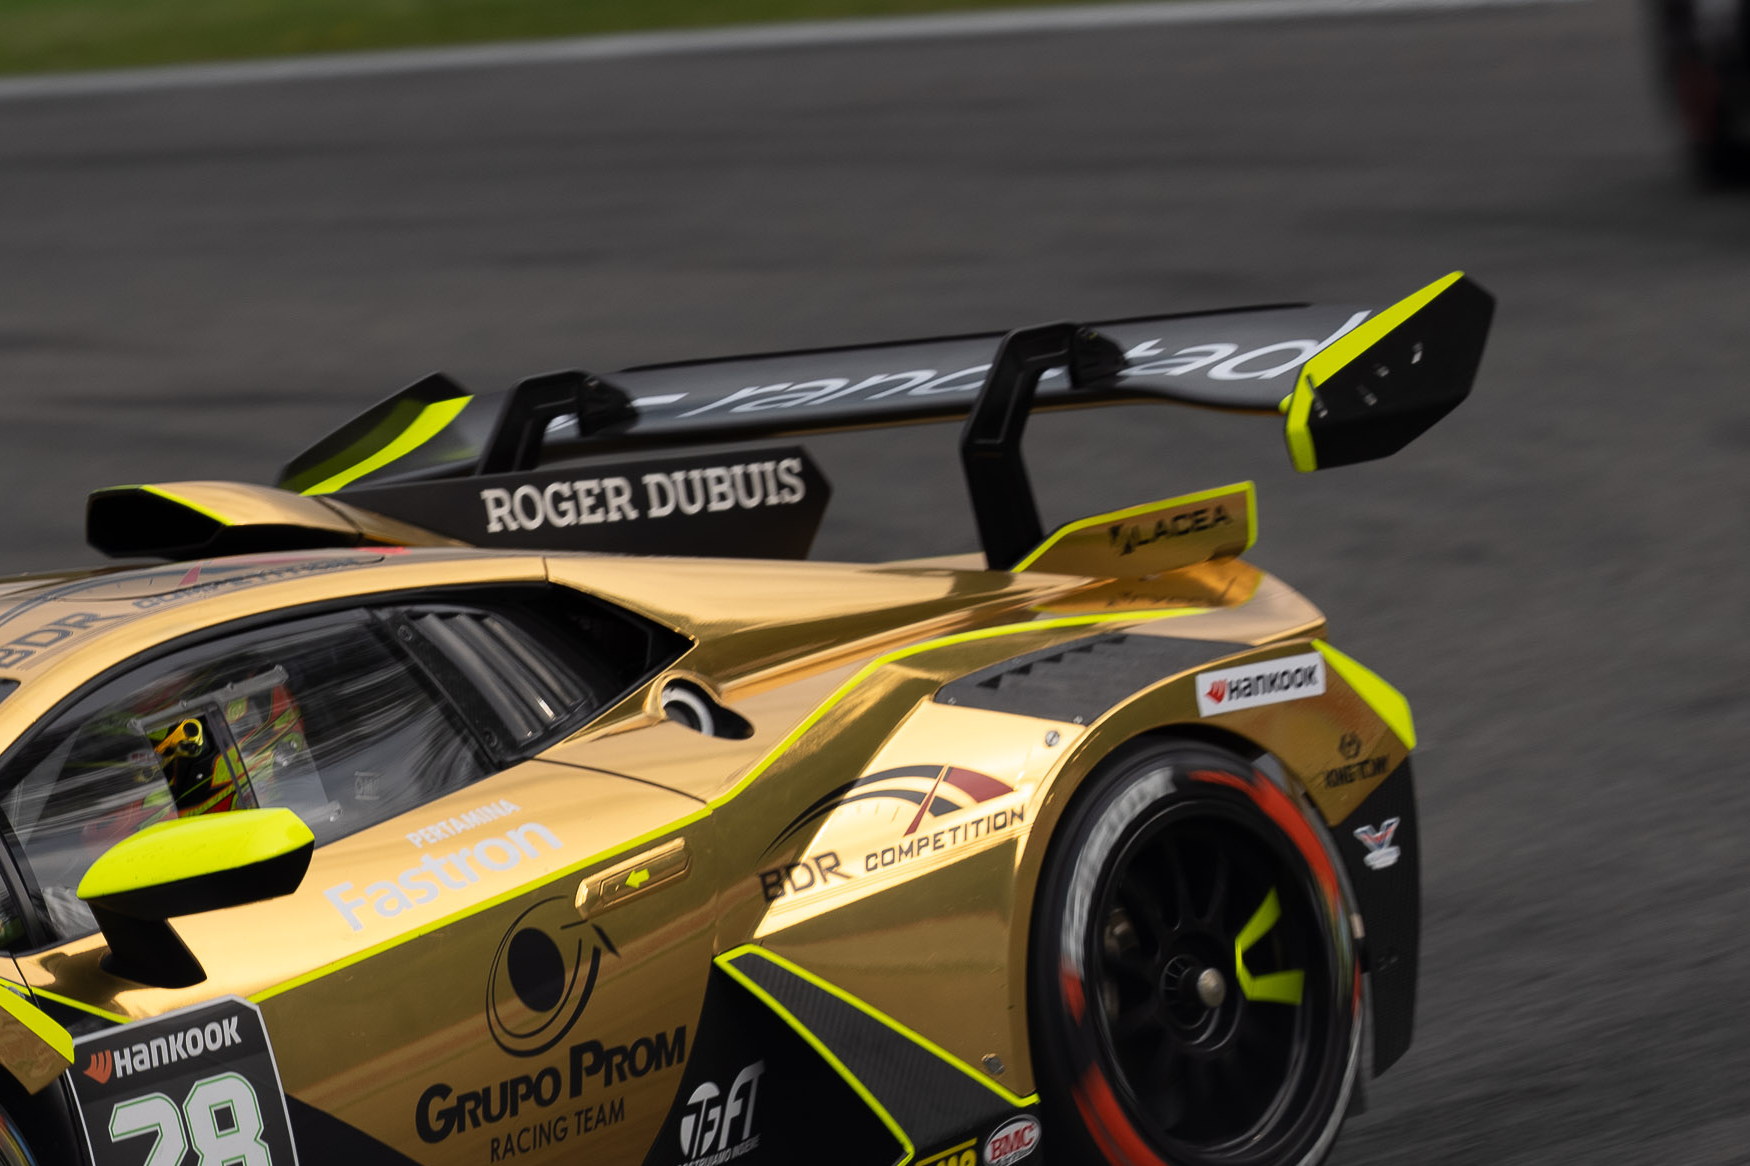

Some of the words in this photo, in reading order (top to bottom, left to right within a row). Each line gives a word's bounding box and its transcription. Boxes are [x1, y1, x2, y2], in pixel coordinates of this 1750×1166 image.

[678, 310, 1373, 418] rantad
[480, 476, 639, 533] ROGER
[641, 458, 806, 518] DUBUIS
[405, 799, 522, 848] PERTAMINA
[758, 850, 853, 904] BDR
[865, 804, 1026, 873] COMPETITION
[323, 822, 564, 932] Fastron
[415, 1066, 562, 1144] GRUPO
[568, 1024, 688, 1099] PROM
[490, 1115, 568, 1164] RACING
[575, 1096, 625, 1136] TEAM
[989, 1122, 1036, 1163] BMC
